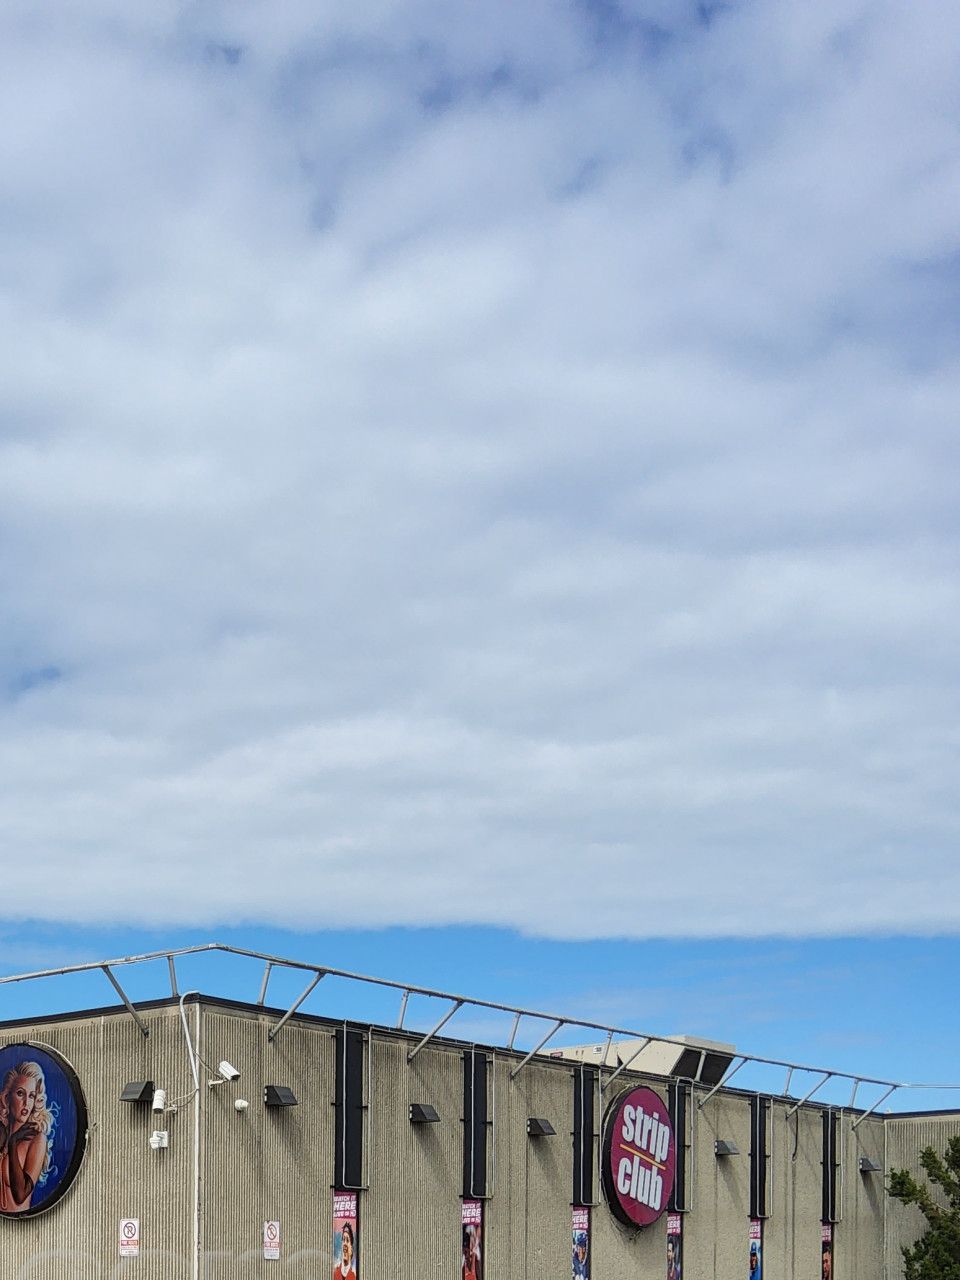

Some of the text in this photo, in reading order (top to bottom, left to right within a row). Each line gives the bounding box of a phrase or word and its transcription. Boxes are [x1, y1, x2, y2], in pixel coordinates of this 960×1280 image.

[622, 1104, 670, 1164] strip
[333, 1201, 357, 1210] HERE
[617, 1155, 663, 1211] club
